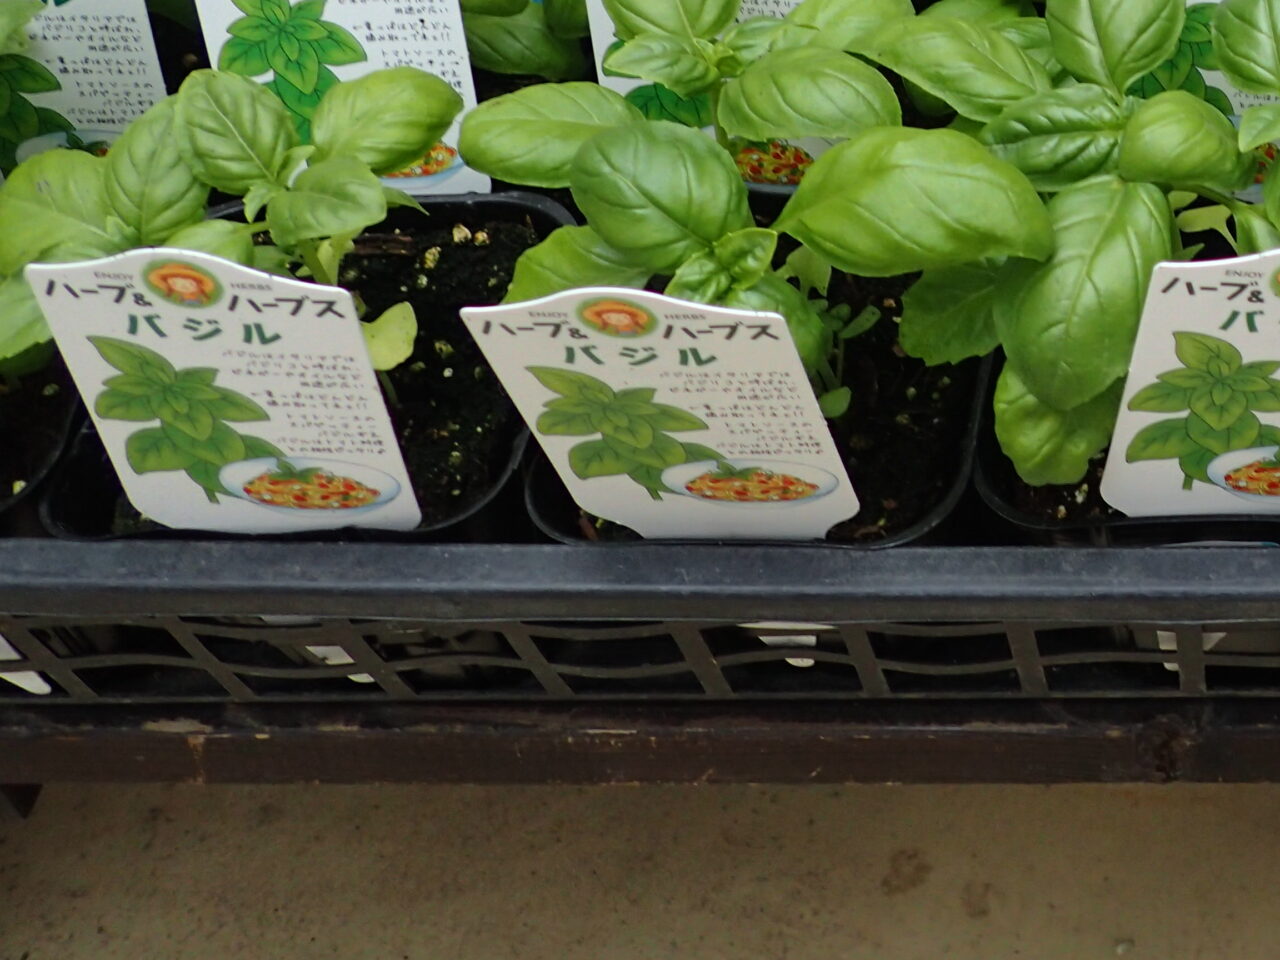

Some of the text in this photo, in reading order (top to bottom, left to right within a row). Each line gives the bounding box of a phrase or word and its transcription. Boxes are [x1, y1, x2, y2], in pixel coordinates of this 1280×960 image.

[94, 271, 272, 291] ENJOY HERBS
[1225, 269, 1266, 278] ENJOY
[228, 295, 346, 319] ハーブス
[528, 310, 706, 321] ENJOY HERBS
[127, 313, 281, 345] バジル
[663, 321, 781, 341] ハーブス
[564, 345, 717, 367] バジル
